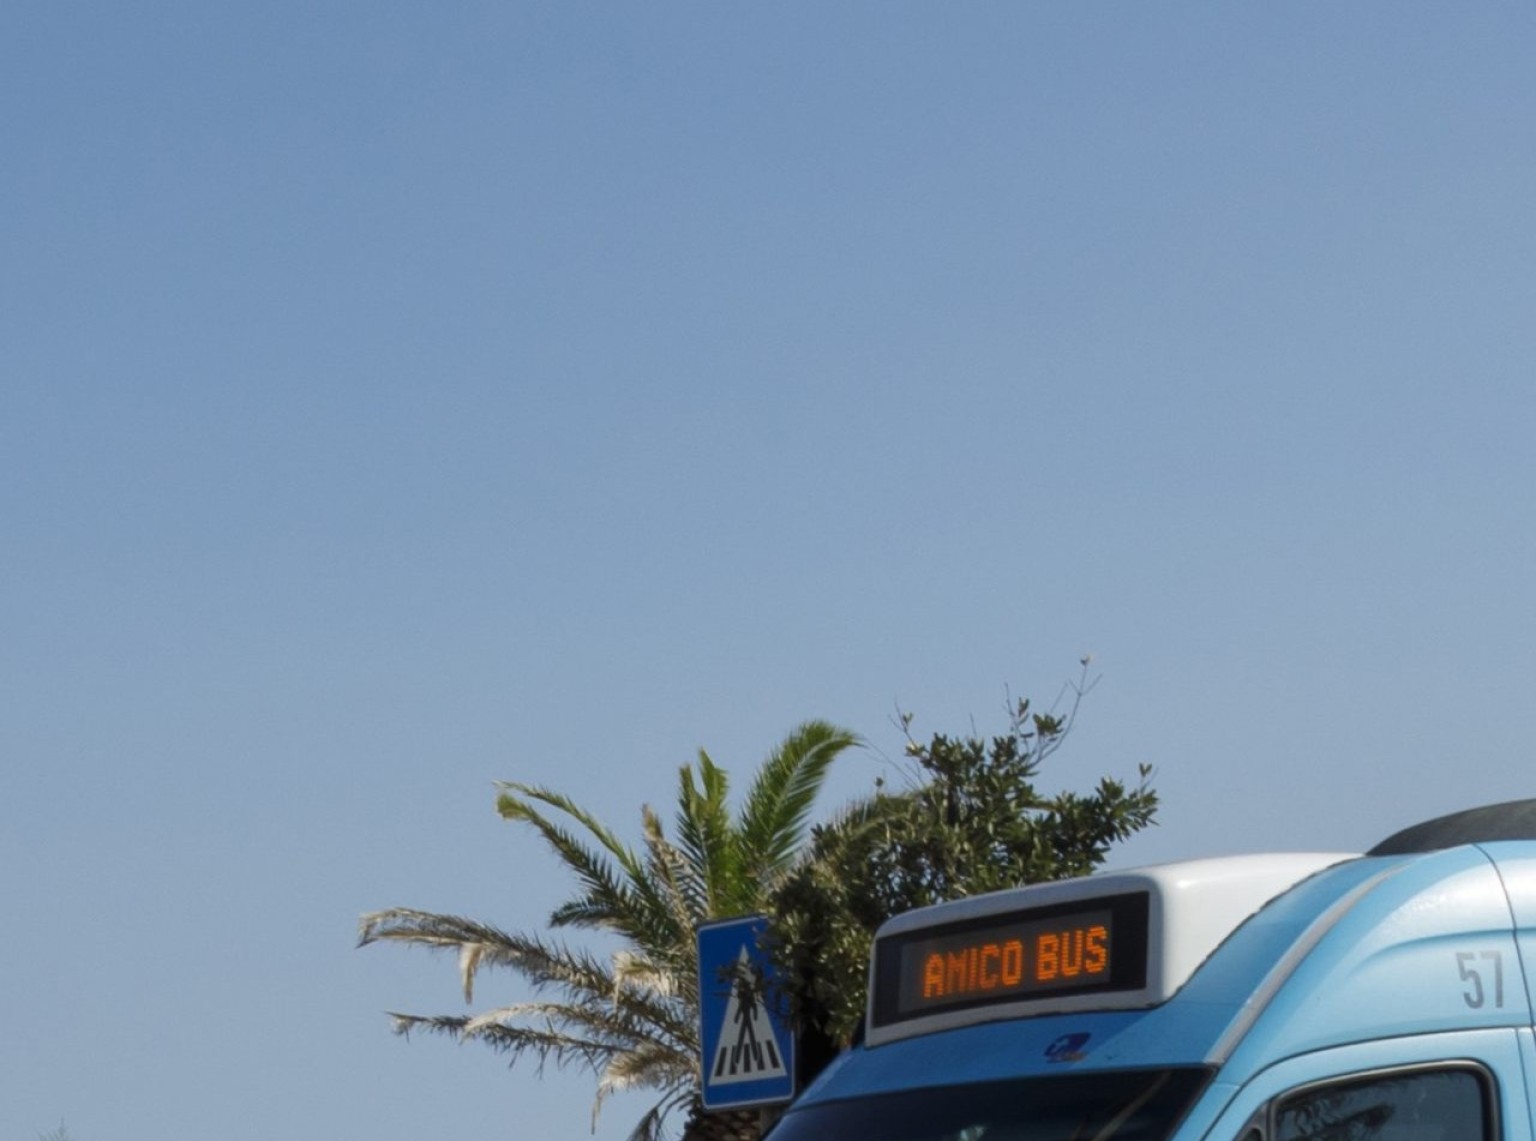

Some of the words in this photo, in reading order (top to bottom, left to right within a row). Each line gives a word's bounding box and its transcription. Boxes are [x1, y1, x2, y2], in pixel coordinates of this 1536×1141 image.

[923, 939, 1023, 998] AMICO
[1036, 925, 1108, 981] BUS
[1456, 950, 1504, 1009] 57
